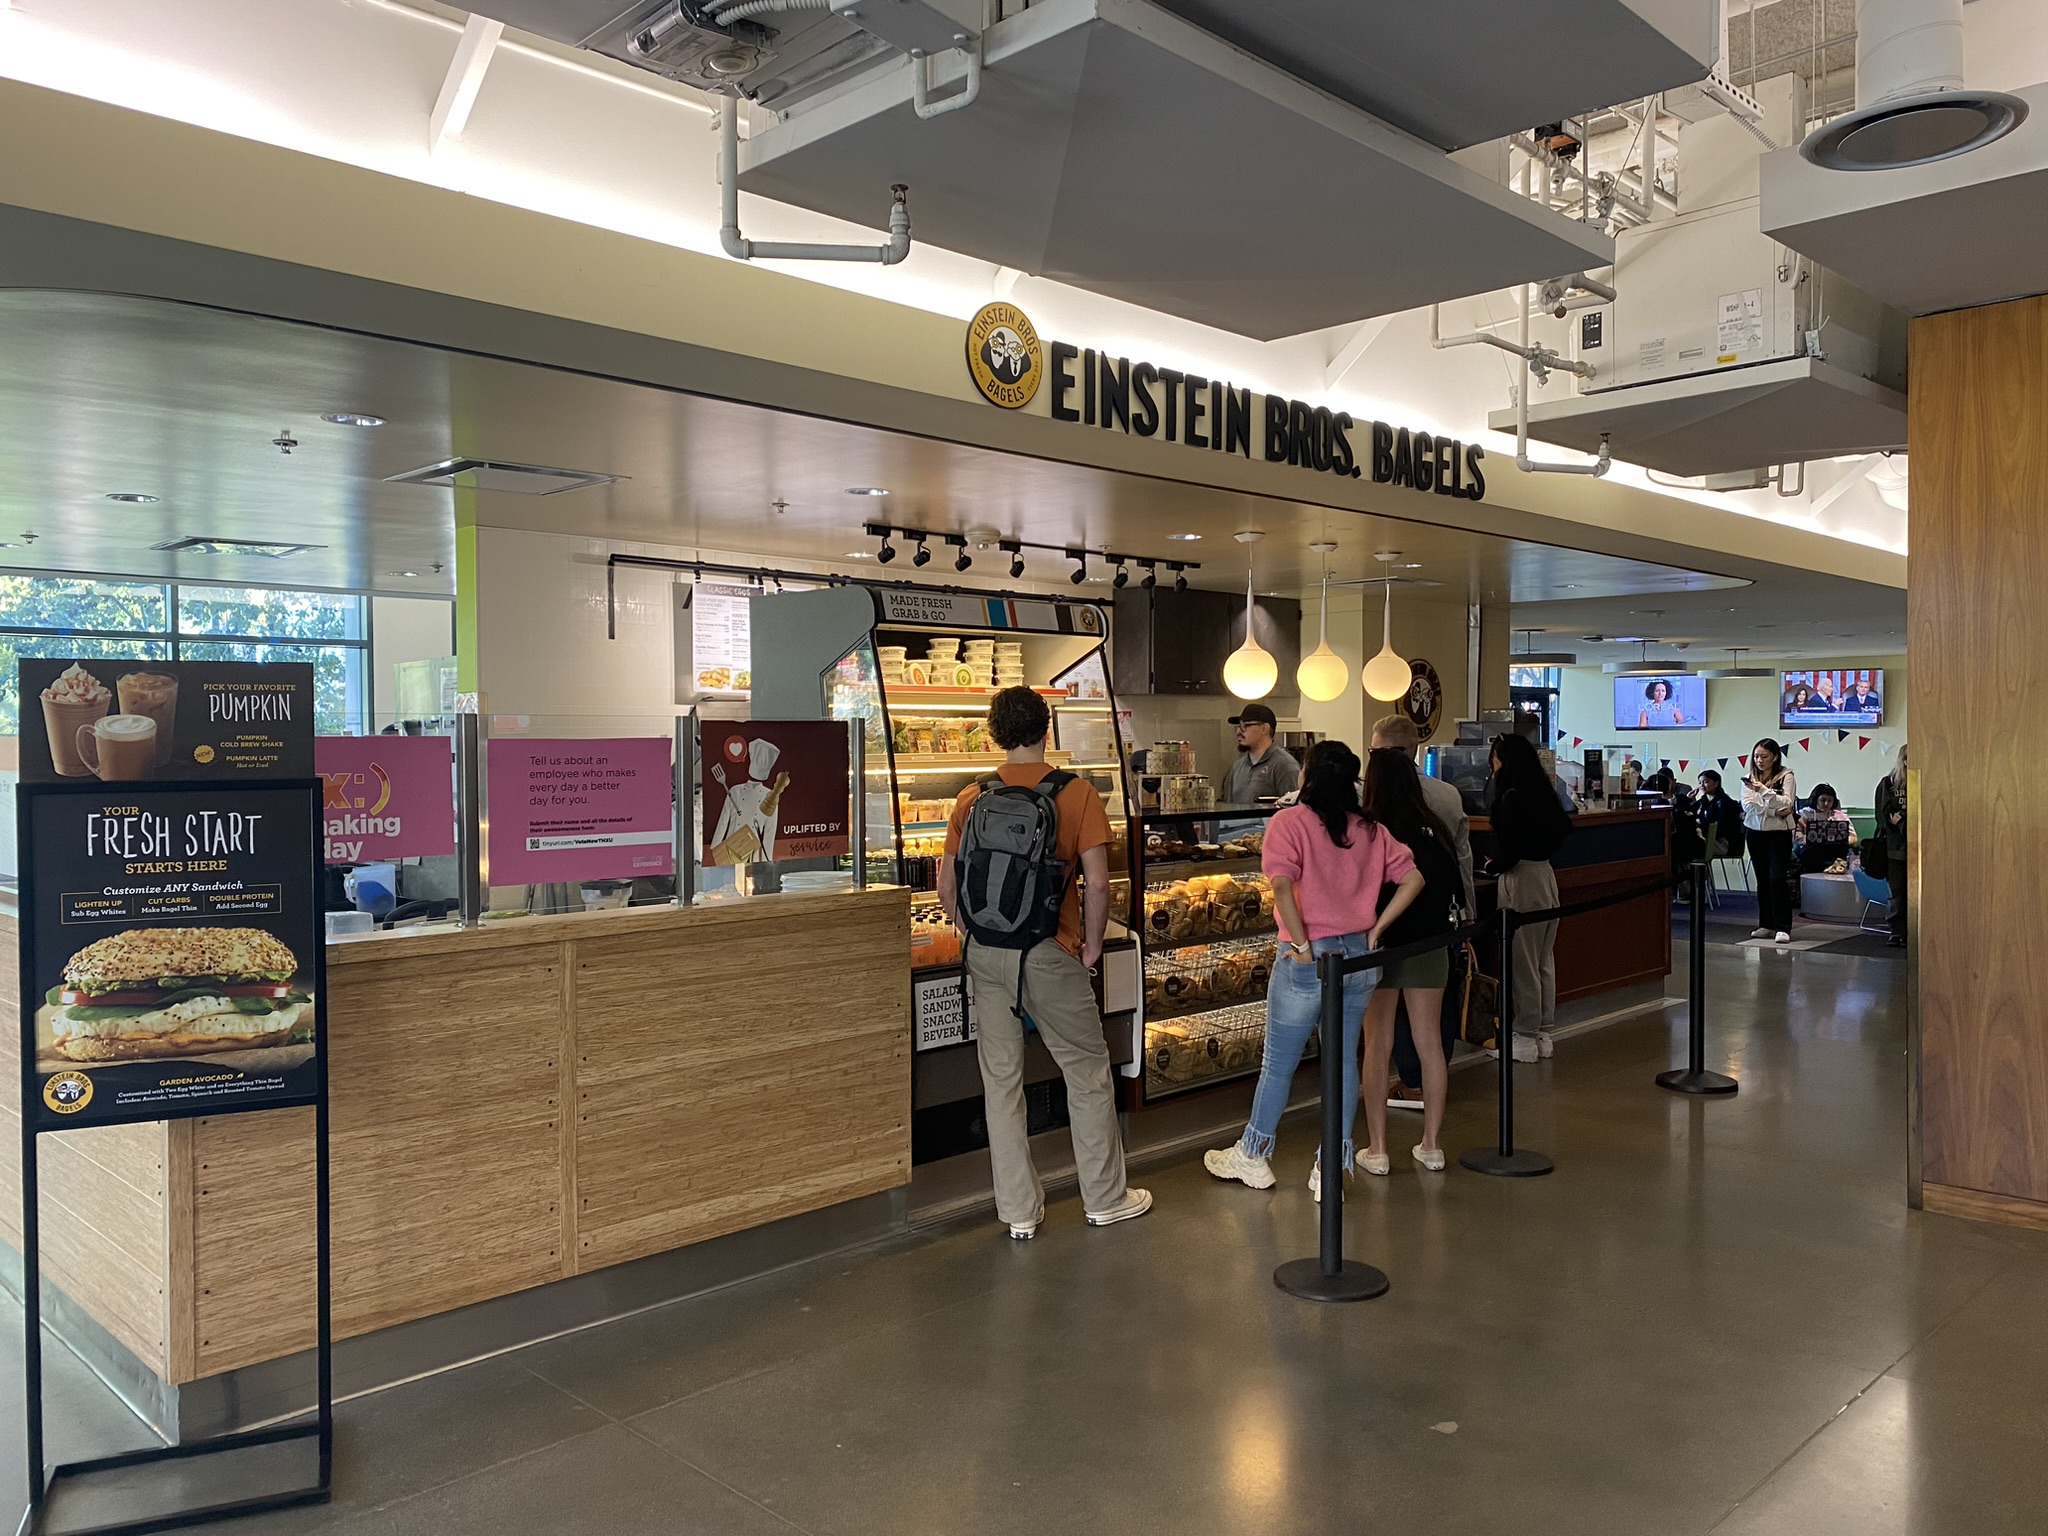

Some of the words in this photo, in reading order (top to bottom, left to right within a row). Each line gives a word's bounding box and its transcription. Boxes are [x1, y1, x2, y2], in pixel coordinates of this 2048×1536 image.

[974, 308, 1016, 341] EINSTEIN
[1017, 319, 1038, 355] BROS
[987, 379, 1025, 403] BAGELS
[1052, 340, 1250, 459] EINSTEIN
[1265, 394, 1361, 479] BROS.
[1373, 420, 1485, 501] BAGELS
[707, 585, 733, 594] CLASSIC
[734, 588, 751, 596] EGGS
[890, 595, 920, 606] MADE
[921, 598, 952, 609] FRESH
[892, 608, 920, 618] GRAB
[922, 610, 928, 620] &
[931, 611, 946, 620] GO
[209, 693, 291, 722] PUMPKIN
[530, 756, 546, 765] Tell
[549, 757, 561, 765] us
[564, 756, 593, 765] about
[596, 757, 608, 765] an
[529, 770, 579, 780] employee
[582, 769, 603, 778] who
[606, 769, 636, 777] makes
[529, 784, 557, 793] every
[560, 782, 579, 793] day
[581, 783, 588, 791] a
[591, 782, 620, 791] better
[529, 796, 548, 807] day
[551, 795, 565, 805] for
[569, 796, 590, 806] you.
[103, 807, 140, 816] YOUR
[87, 812, 170, 859] FRESH
[185, 811, 262, 857] START
[784, 824, 827, 835] UPLIFTED
[829, 822, 841, 832] BY
[789, 838, 833, 857] service
[125, 861, 183, 874] STARTS
[187, 860, 227, 872] HERE
[103, 886, 161, 896] Customize
[163, 883, 190, 893] ANY
[191, 880, 243, 891] Sandwich
[922, 985, 959, 1000] SALAD
[923, 996, 975, 1014] SANDWC
[923, 1023, 978, 1042] BEVERAE
[46, 1073, 74, 1091] EINSTEIN
[75, 1074, 90, 1088] BROS
[159, 1078, 192, 1086] GARDEN
[194, 1074, 233, 1083] AVOCADO
[55, 1102, 82, 1112] BAGELS
